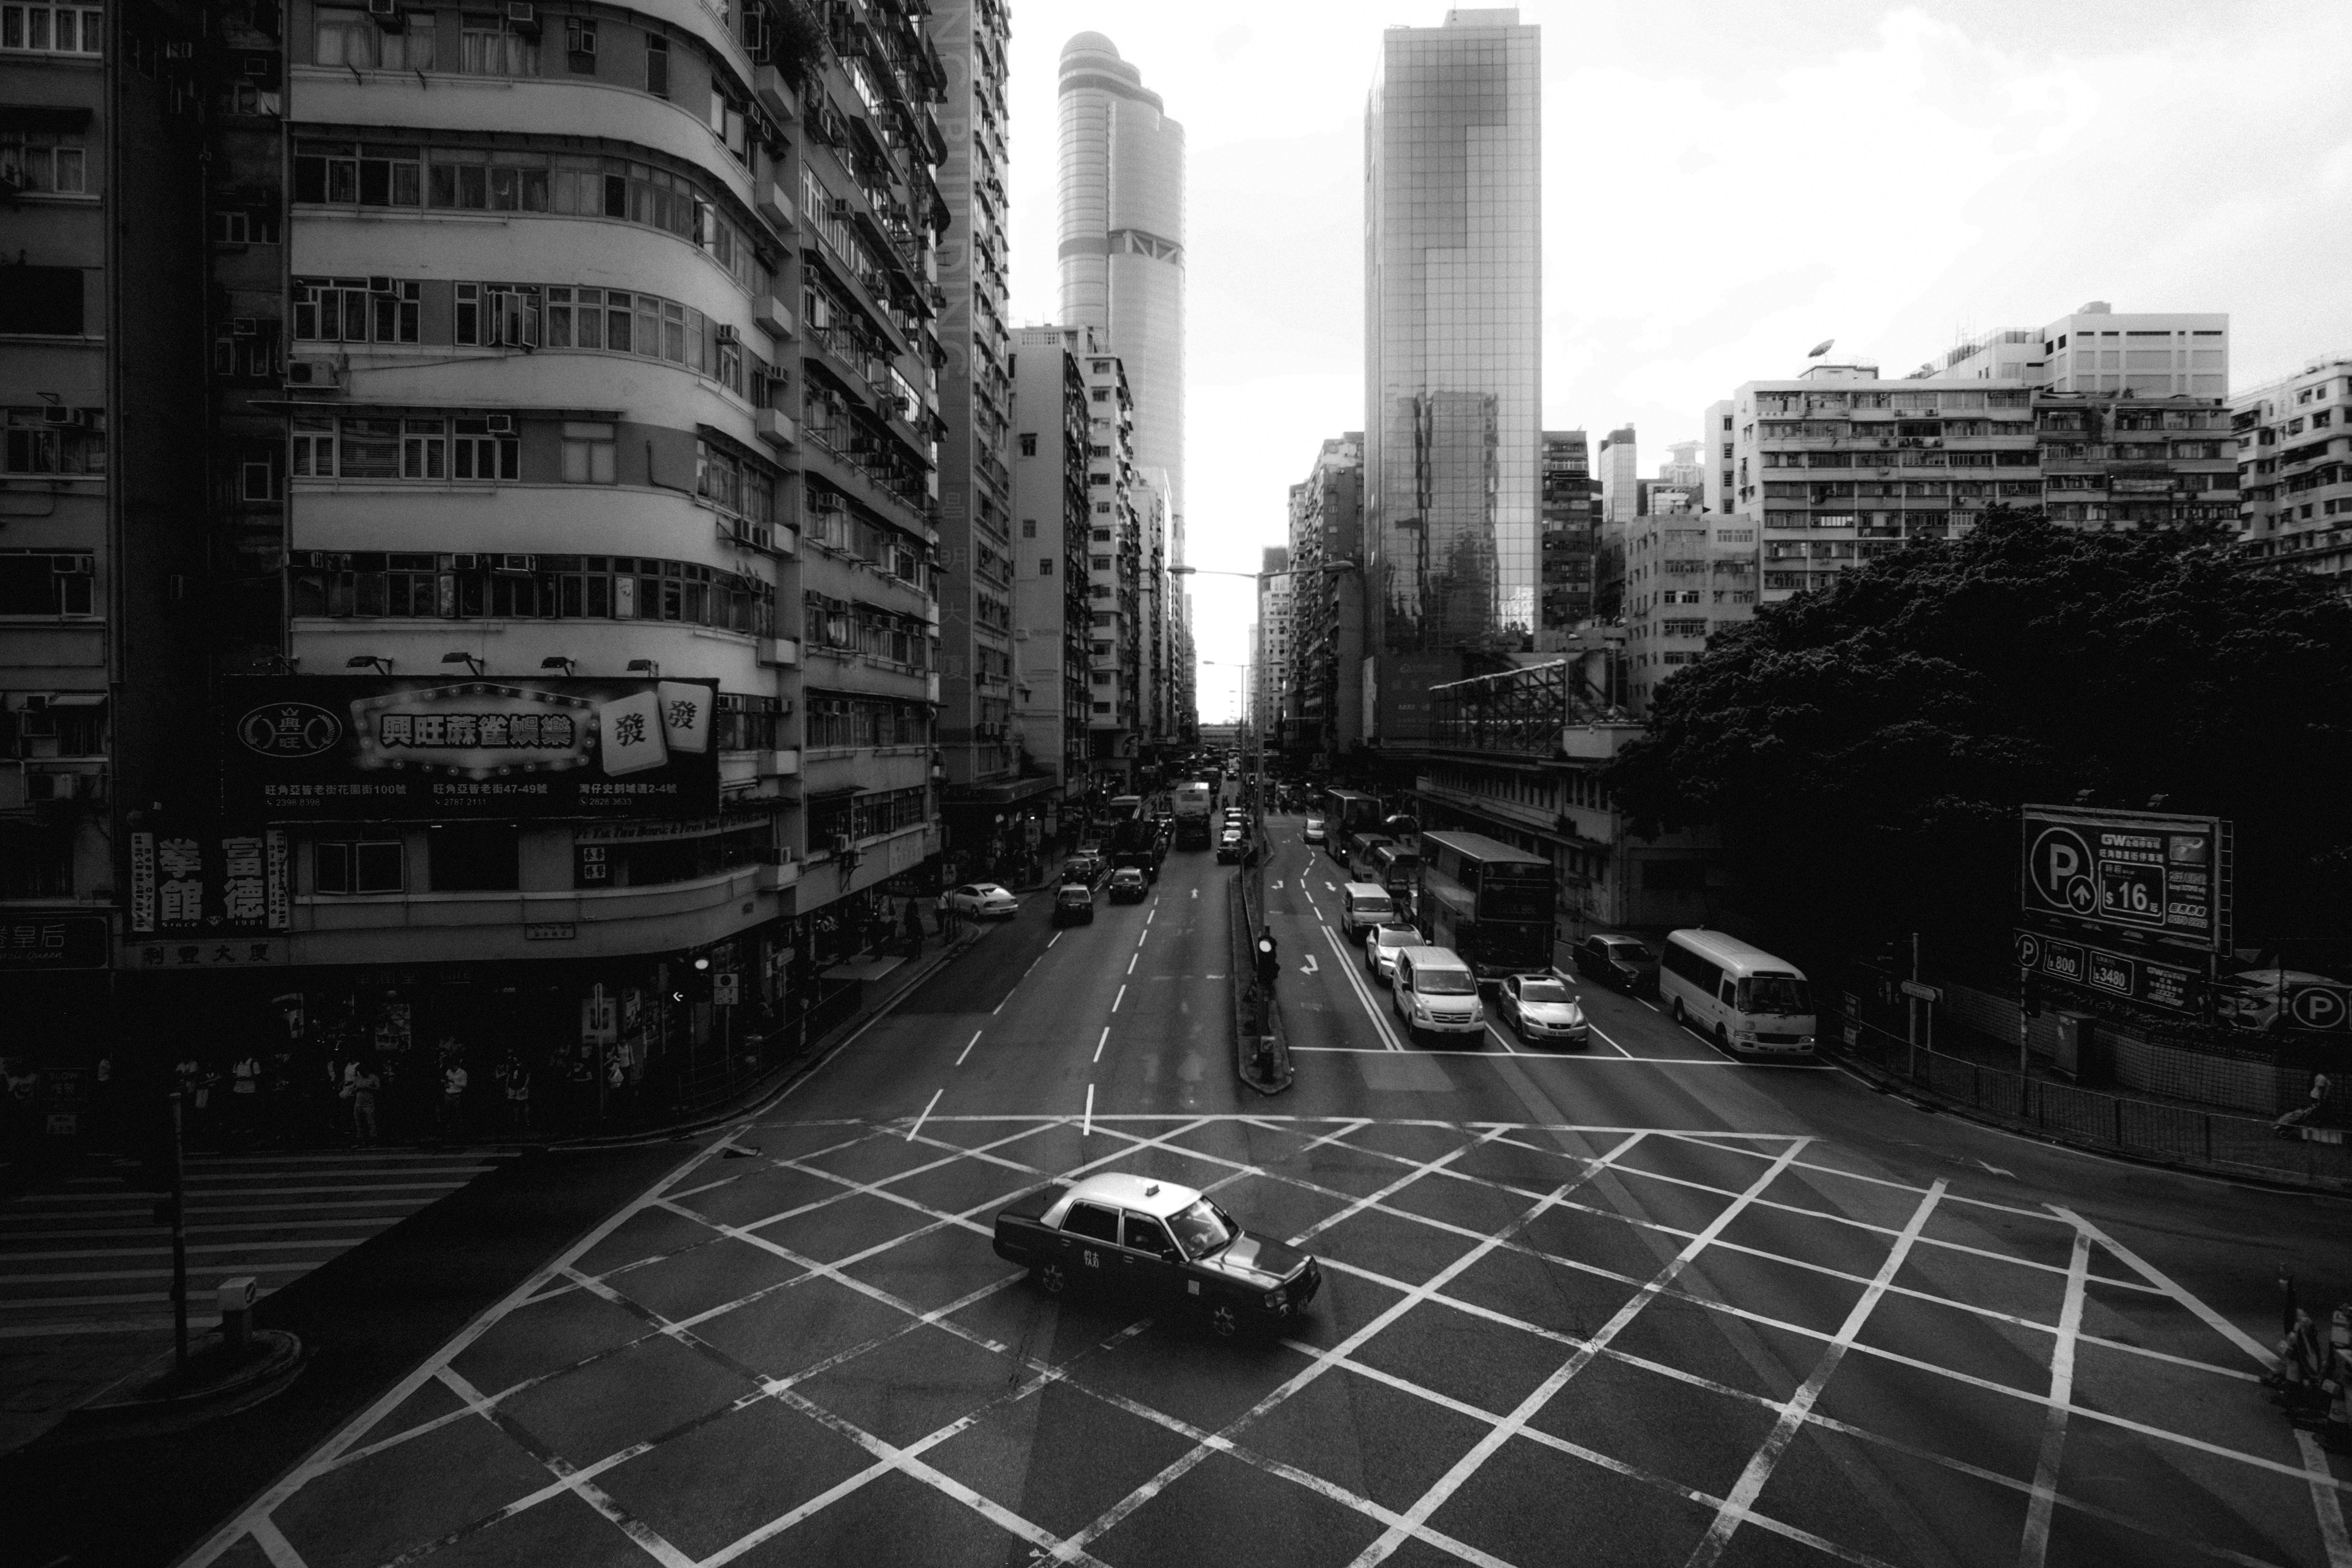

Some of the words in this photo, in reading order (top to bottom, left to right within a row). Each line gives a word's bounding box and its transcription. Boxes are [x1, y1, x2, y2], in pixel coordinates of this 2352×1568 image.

[669, 700, 697, 730] 發
[615, 713, 646, 747] 發
[2050, 843, 2079, 891] P
[2309, 995, 2334, 1020] P
[1084, 1249, 1100, 1259] 的士
[1085, 1258, 1099, 1269] TAXI
